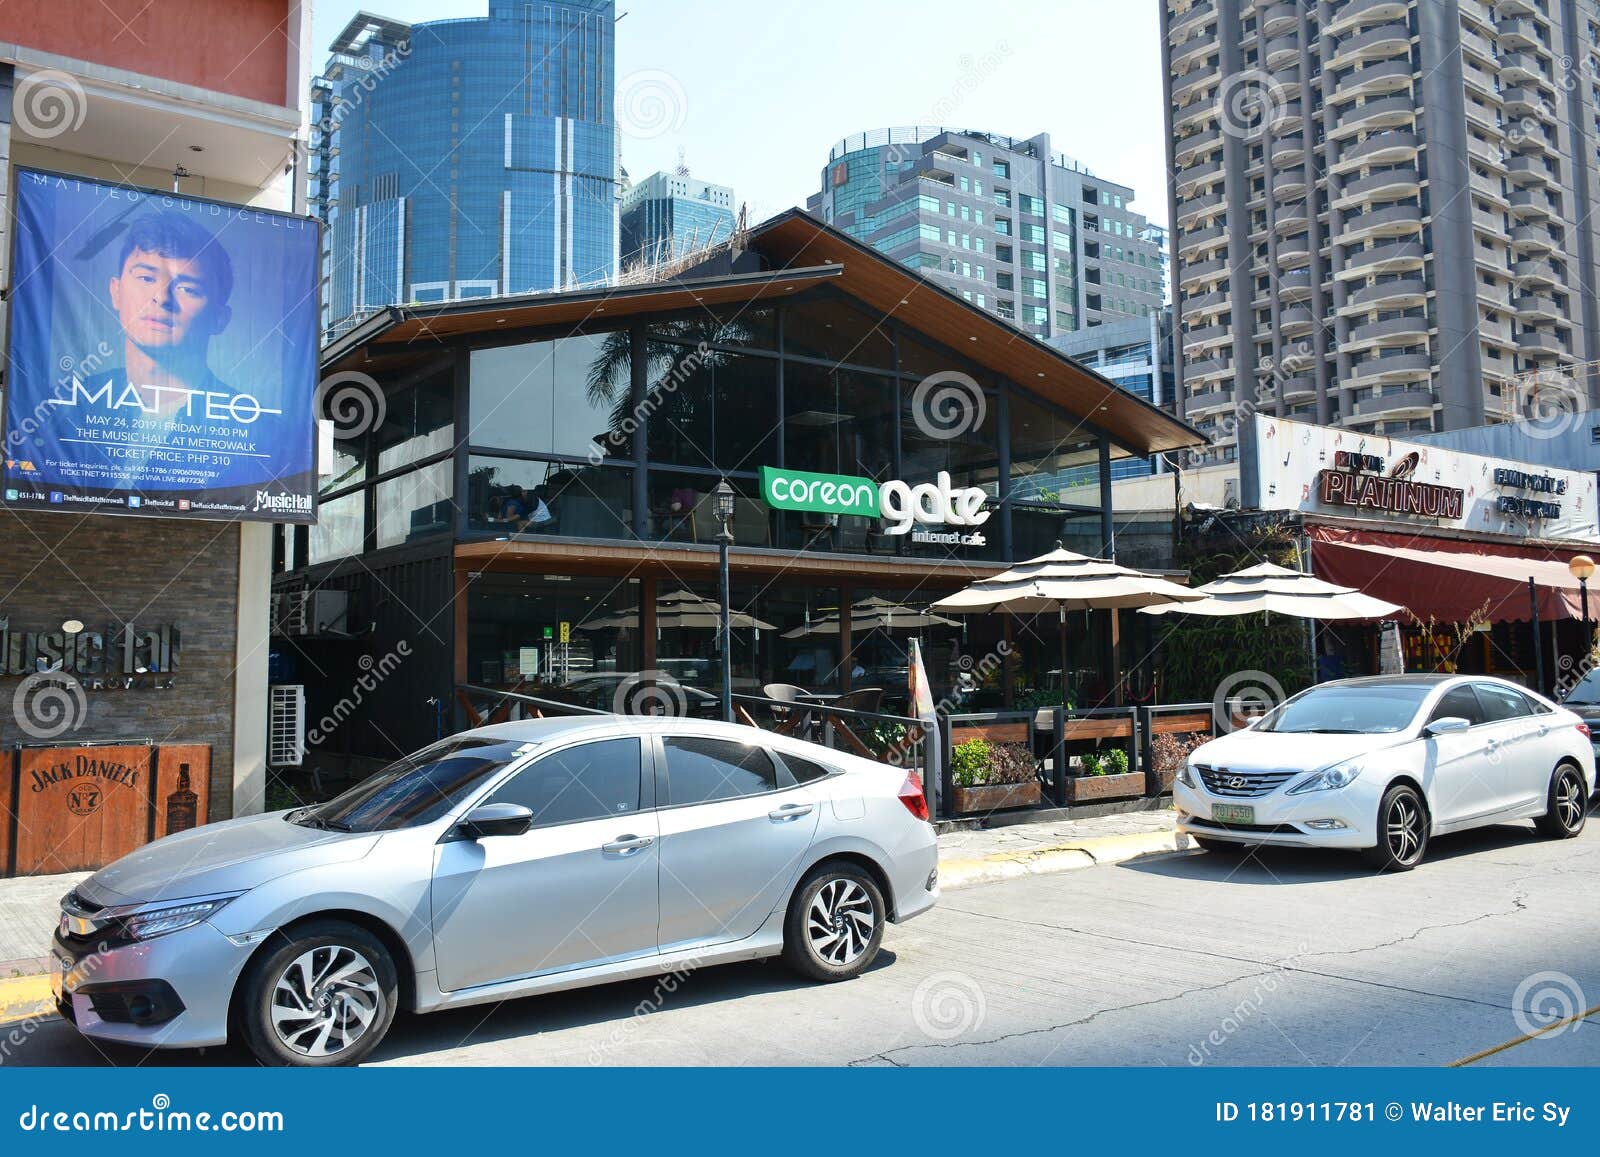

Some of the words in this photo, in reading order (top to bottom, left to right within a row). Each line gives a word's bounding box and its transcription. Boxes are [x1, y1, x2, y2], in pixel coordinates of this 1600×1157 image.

[33, 173, 139, 202] MATTEO
[161, 196, 304, 231] GUIDICELLI
[48, 374, 282, 423] MATTEO
[86, 414, 111, 426] MAY
[113, 418, 129, 429] 24,
[131, 419, 157, 430] 2019
[164, 421, 201, 435] FRIDAY
[209, 426, 230, 438] 9:00
[232, 428, 248, 438] PM
[76, 428, 99, 439] THE
[102, 430, 139, 443] MUSIC
[142, 434, 170, 446] HALL
[172, 436, 185, 447] AT
[188, 438, 256, 452] METROWALK
[46, 459, 58, 467] For
[59, 460, 78, 469] ticket
[106, 447, 147, 459] TICKET
[150, 451, 185, 463] PRICE:
[187, 454, 210, 464] PHP
[212, 456, 231, 467] 310
[60, 468, 101, 478] TICKETNET
[771, 477, 873, 508] coreon
[879, 470, 991, 535] gate
[1319, 468, 1464, 520] PLATINUM
[911, 531, 960, 544] internet
[961, 533, 986, 546] cafe
[30, 761, 73, 793] JACK
